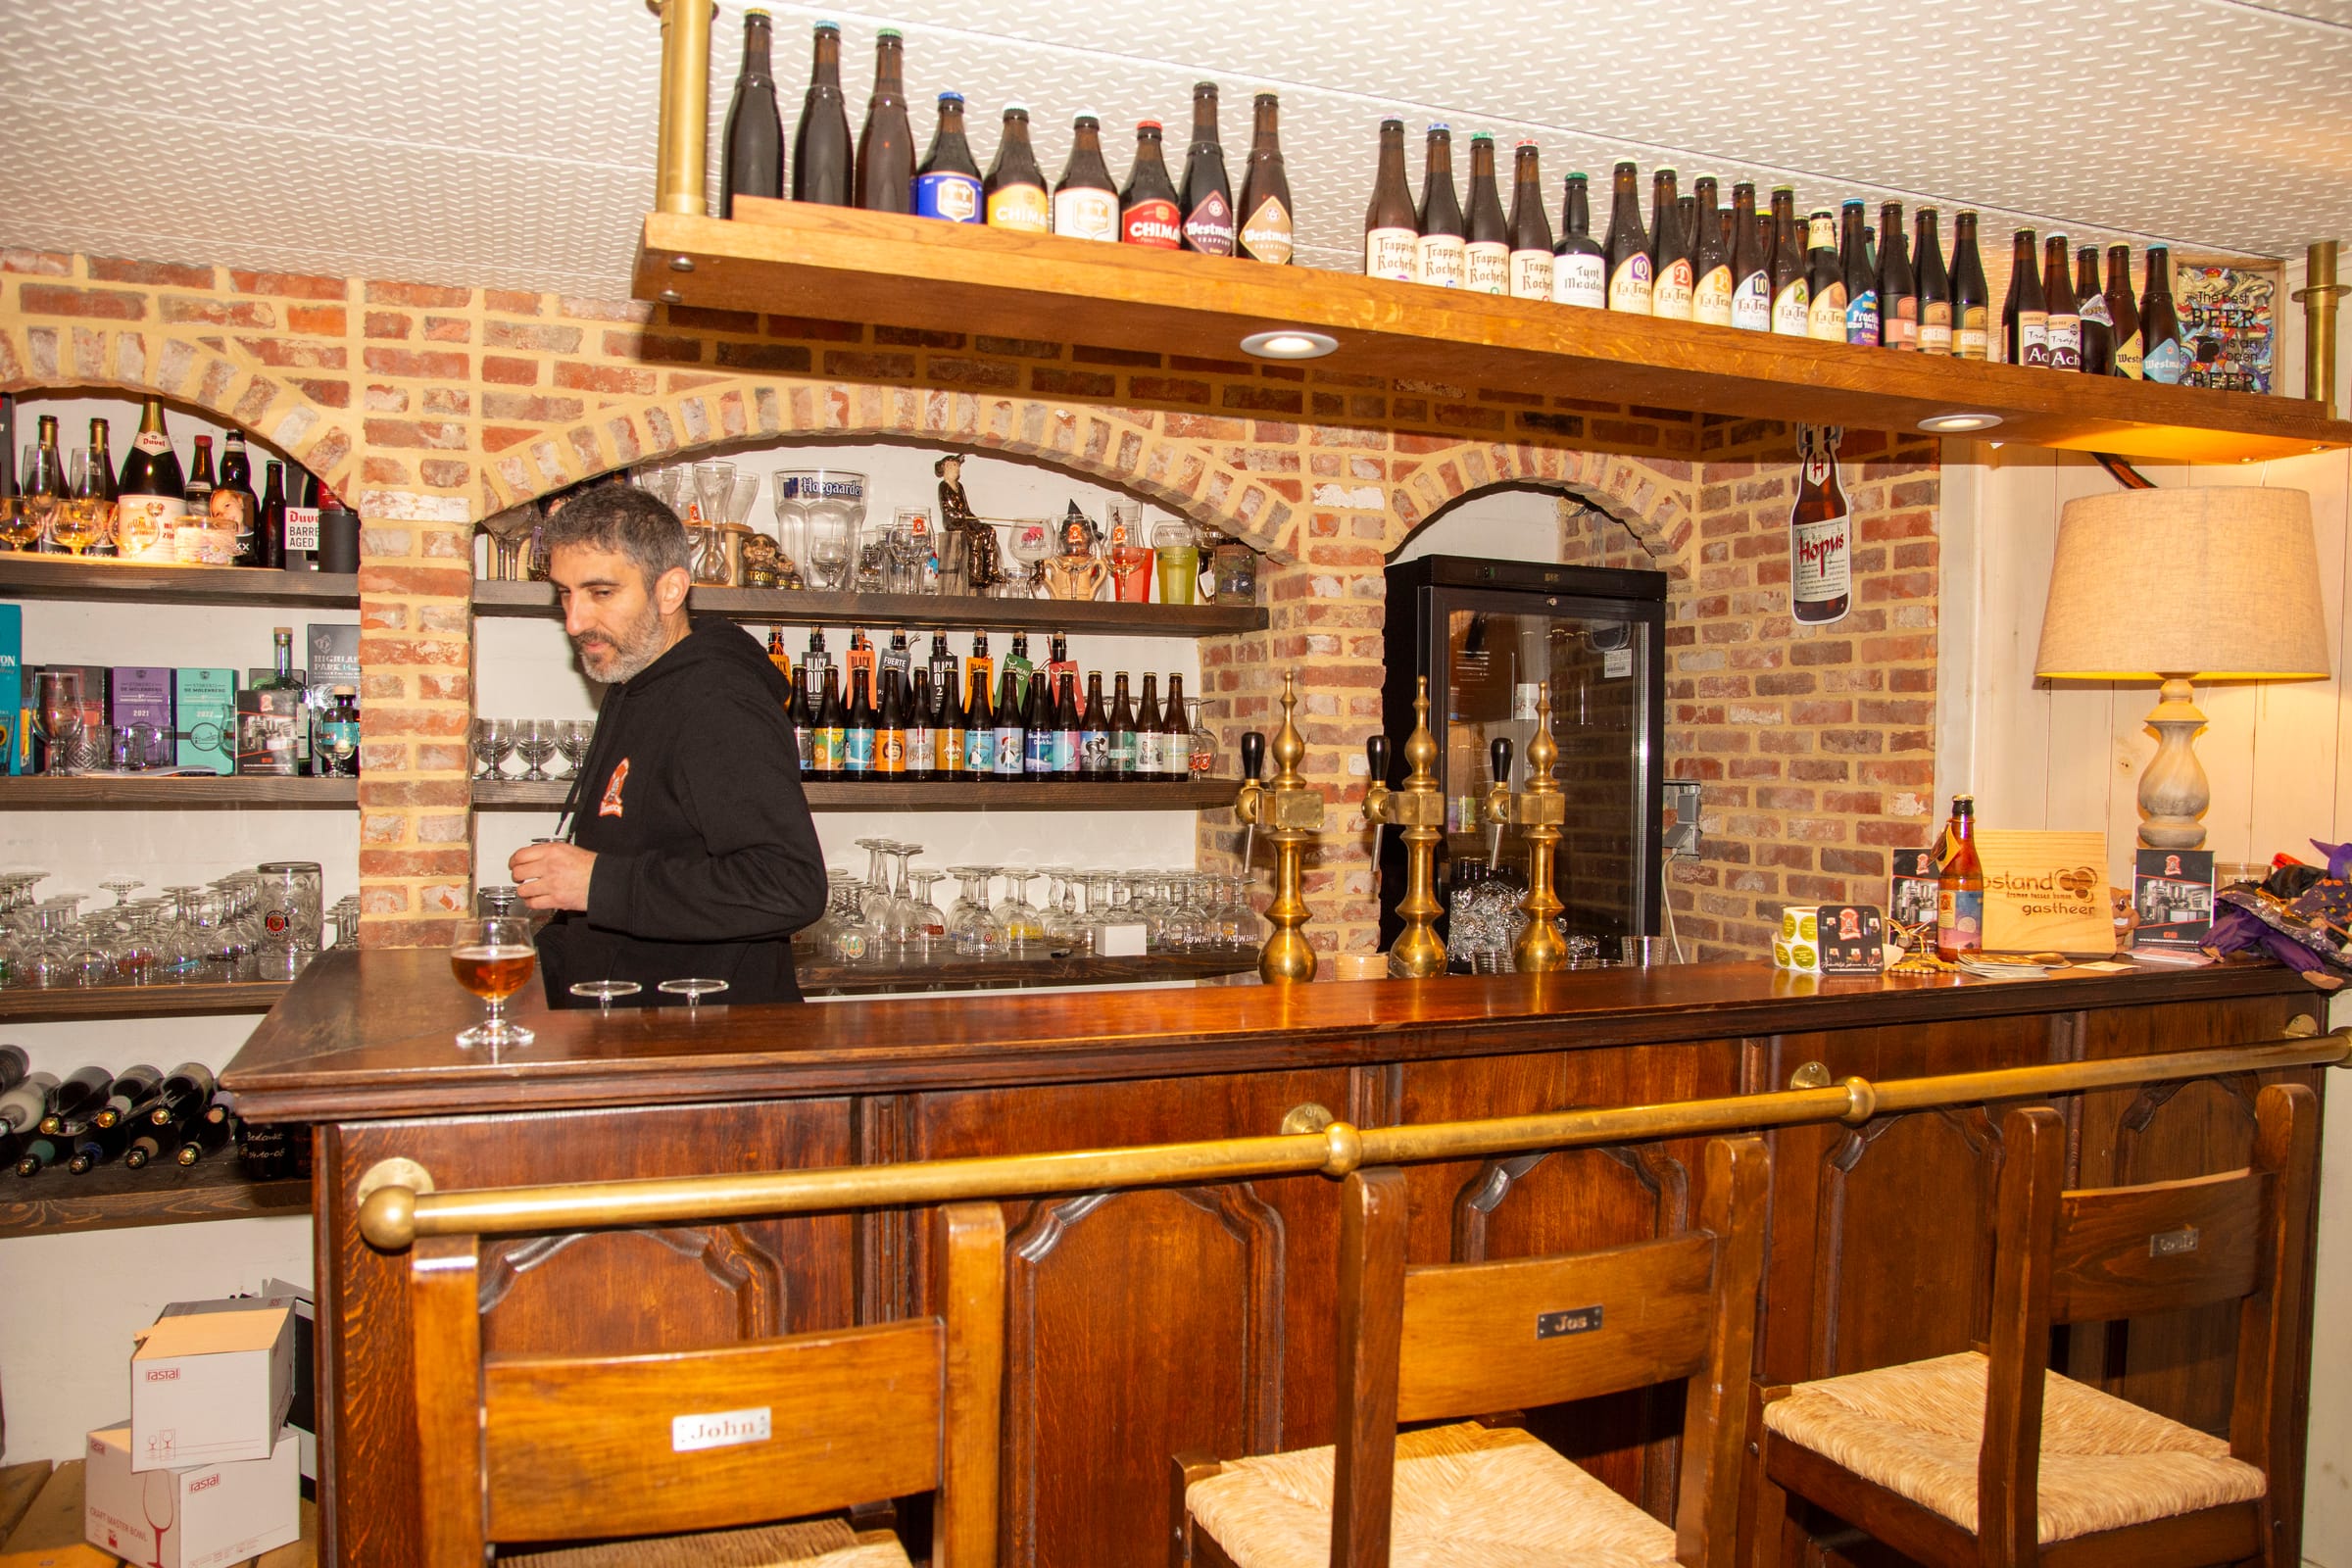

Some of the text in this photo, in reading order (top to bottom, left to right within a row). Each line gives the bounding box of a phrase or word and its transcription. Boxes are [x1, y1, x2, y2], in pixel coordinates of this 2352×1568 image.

[1634, 256, 1647, 279] Q
[1676, 266, 1690, 284] D
[1753, 275, 1767, 296] W
[2198, 291, 2250, 304] The best
[2190, 308, 2257, 329] BEER
[2226, 354, 2258, 365] open
[2191, 371, 2257, 392] BEER
[143, 437, 166, 447] Duvel
[1812, 452, 1824, 480] H
[290, 537, 314, 548] AGED
[1798, 532, 1844, 578] Hopus
[747, 571, 773, 581] TROH
[884, 657, 906, 667] FUERTE
[2022, 903, 2095, 916] gastheer
[147, 1369, 178, 1381] rastal
[691, 1420, 755, 1441] John
[190, 1473, 220, 1493] rastal
